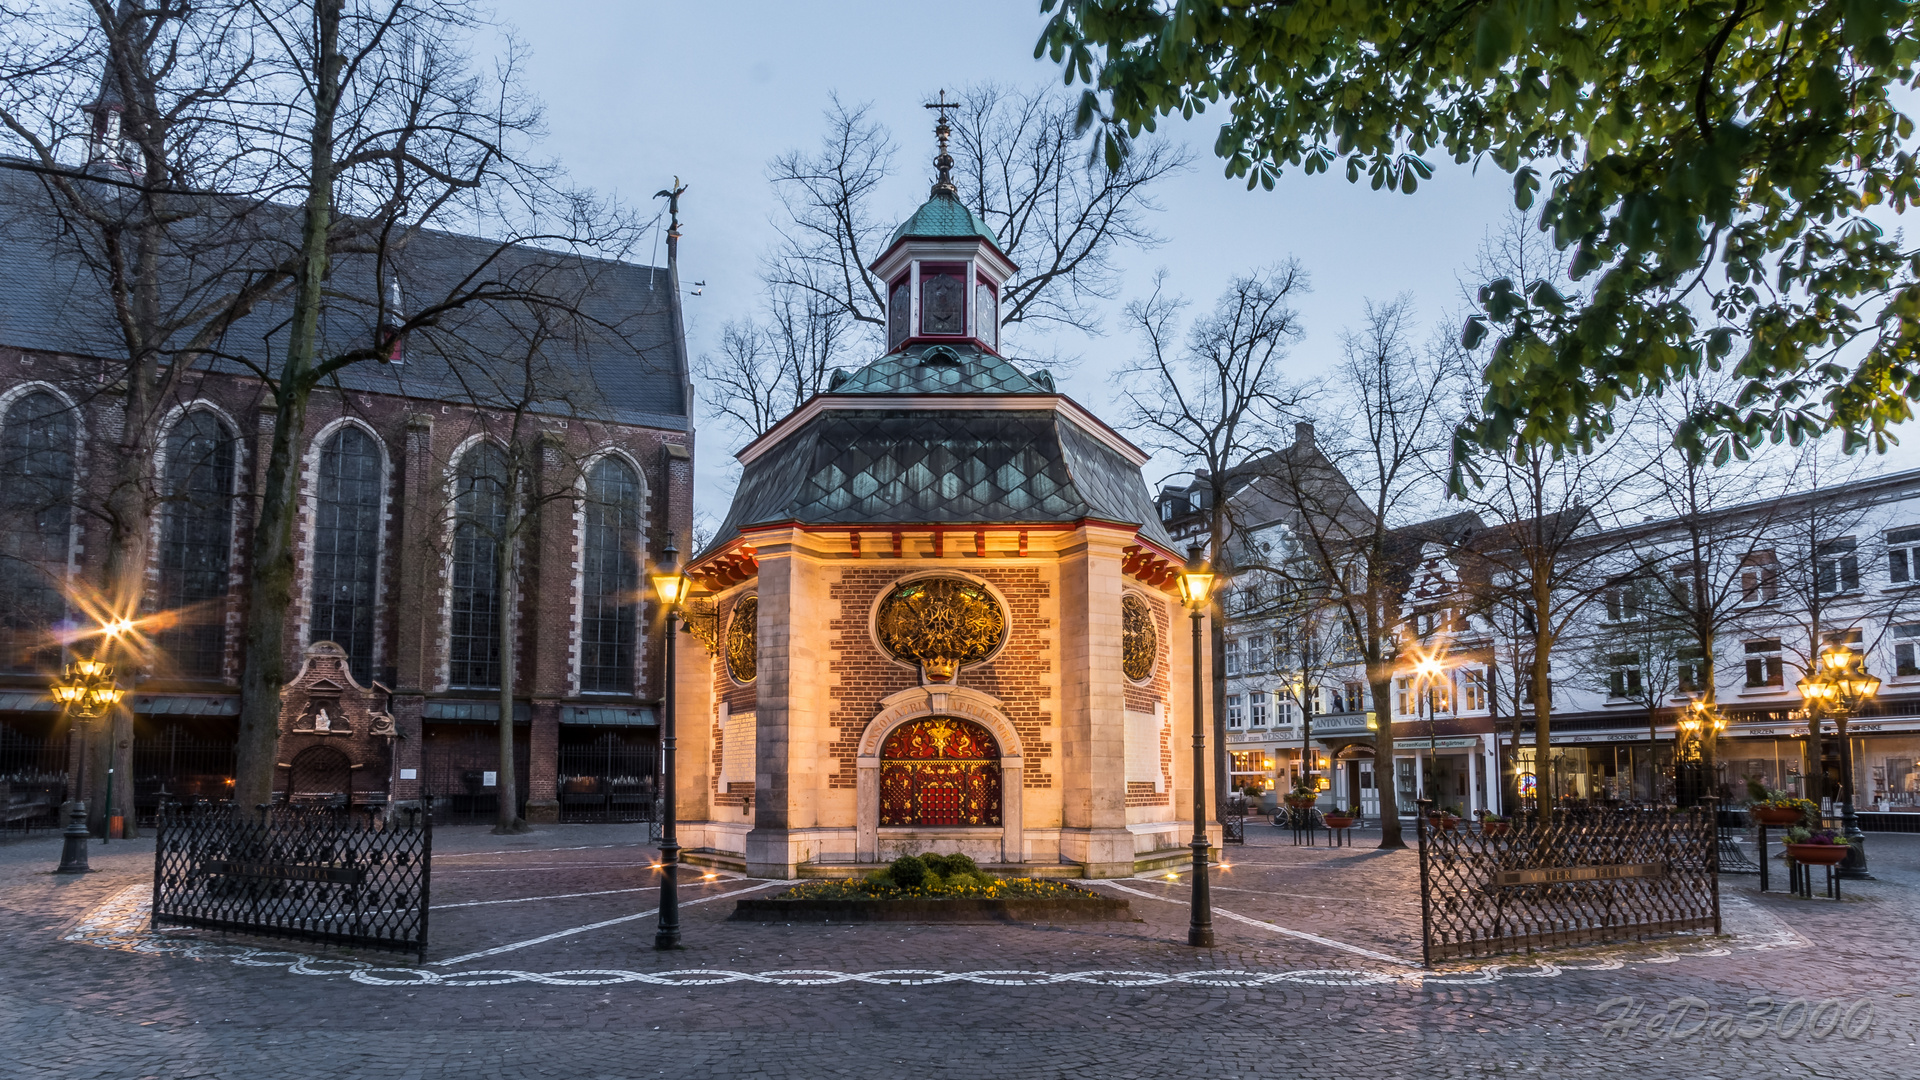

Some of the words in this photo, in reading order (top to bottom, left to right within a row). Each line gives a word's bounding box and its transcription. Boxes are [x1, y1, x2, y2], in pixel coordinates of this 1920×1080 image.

[1315, 718, 1341, 728] ANTON
[1343, 717, 1366, 726] VOSS
[1262, 731, 1294, 741] WEISSEN
[229, 864, 247, 873] AVE
[253, 865, 278, 875] SPES
[284, 868, 328, 879] NOSTRA
[1530, 870, 1571, 881] MATER
[1577, 867, 1634, 878] FIDELIUM
